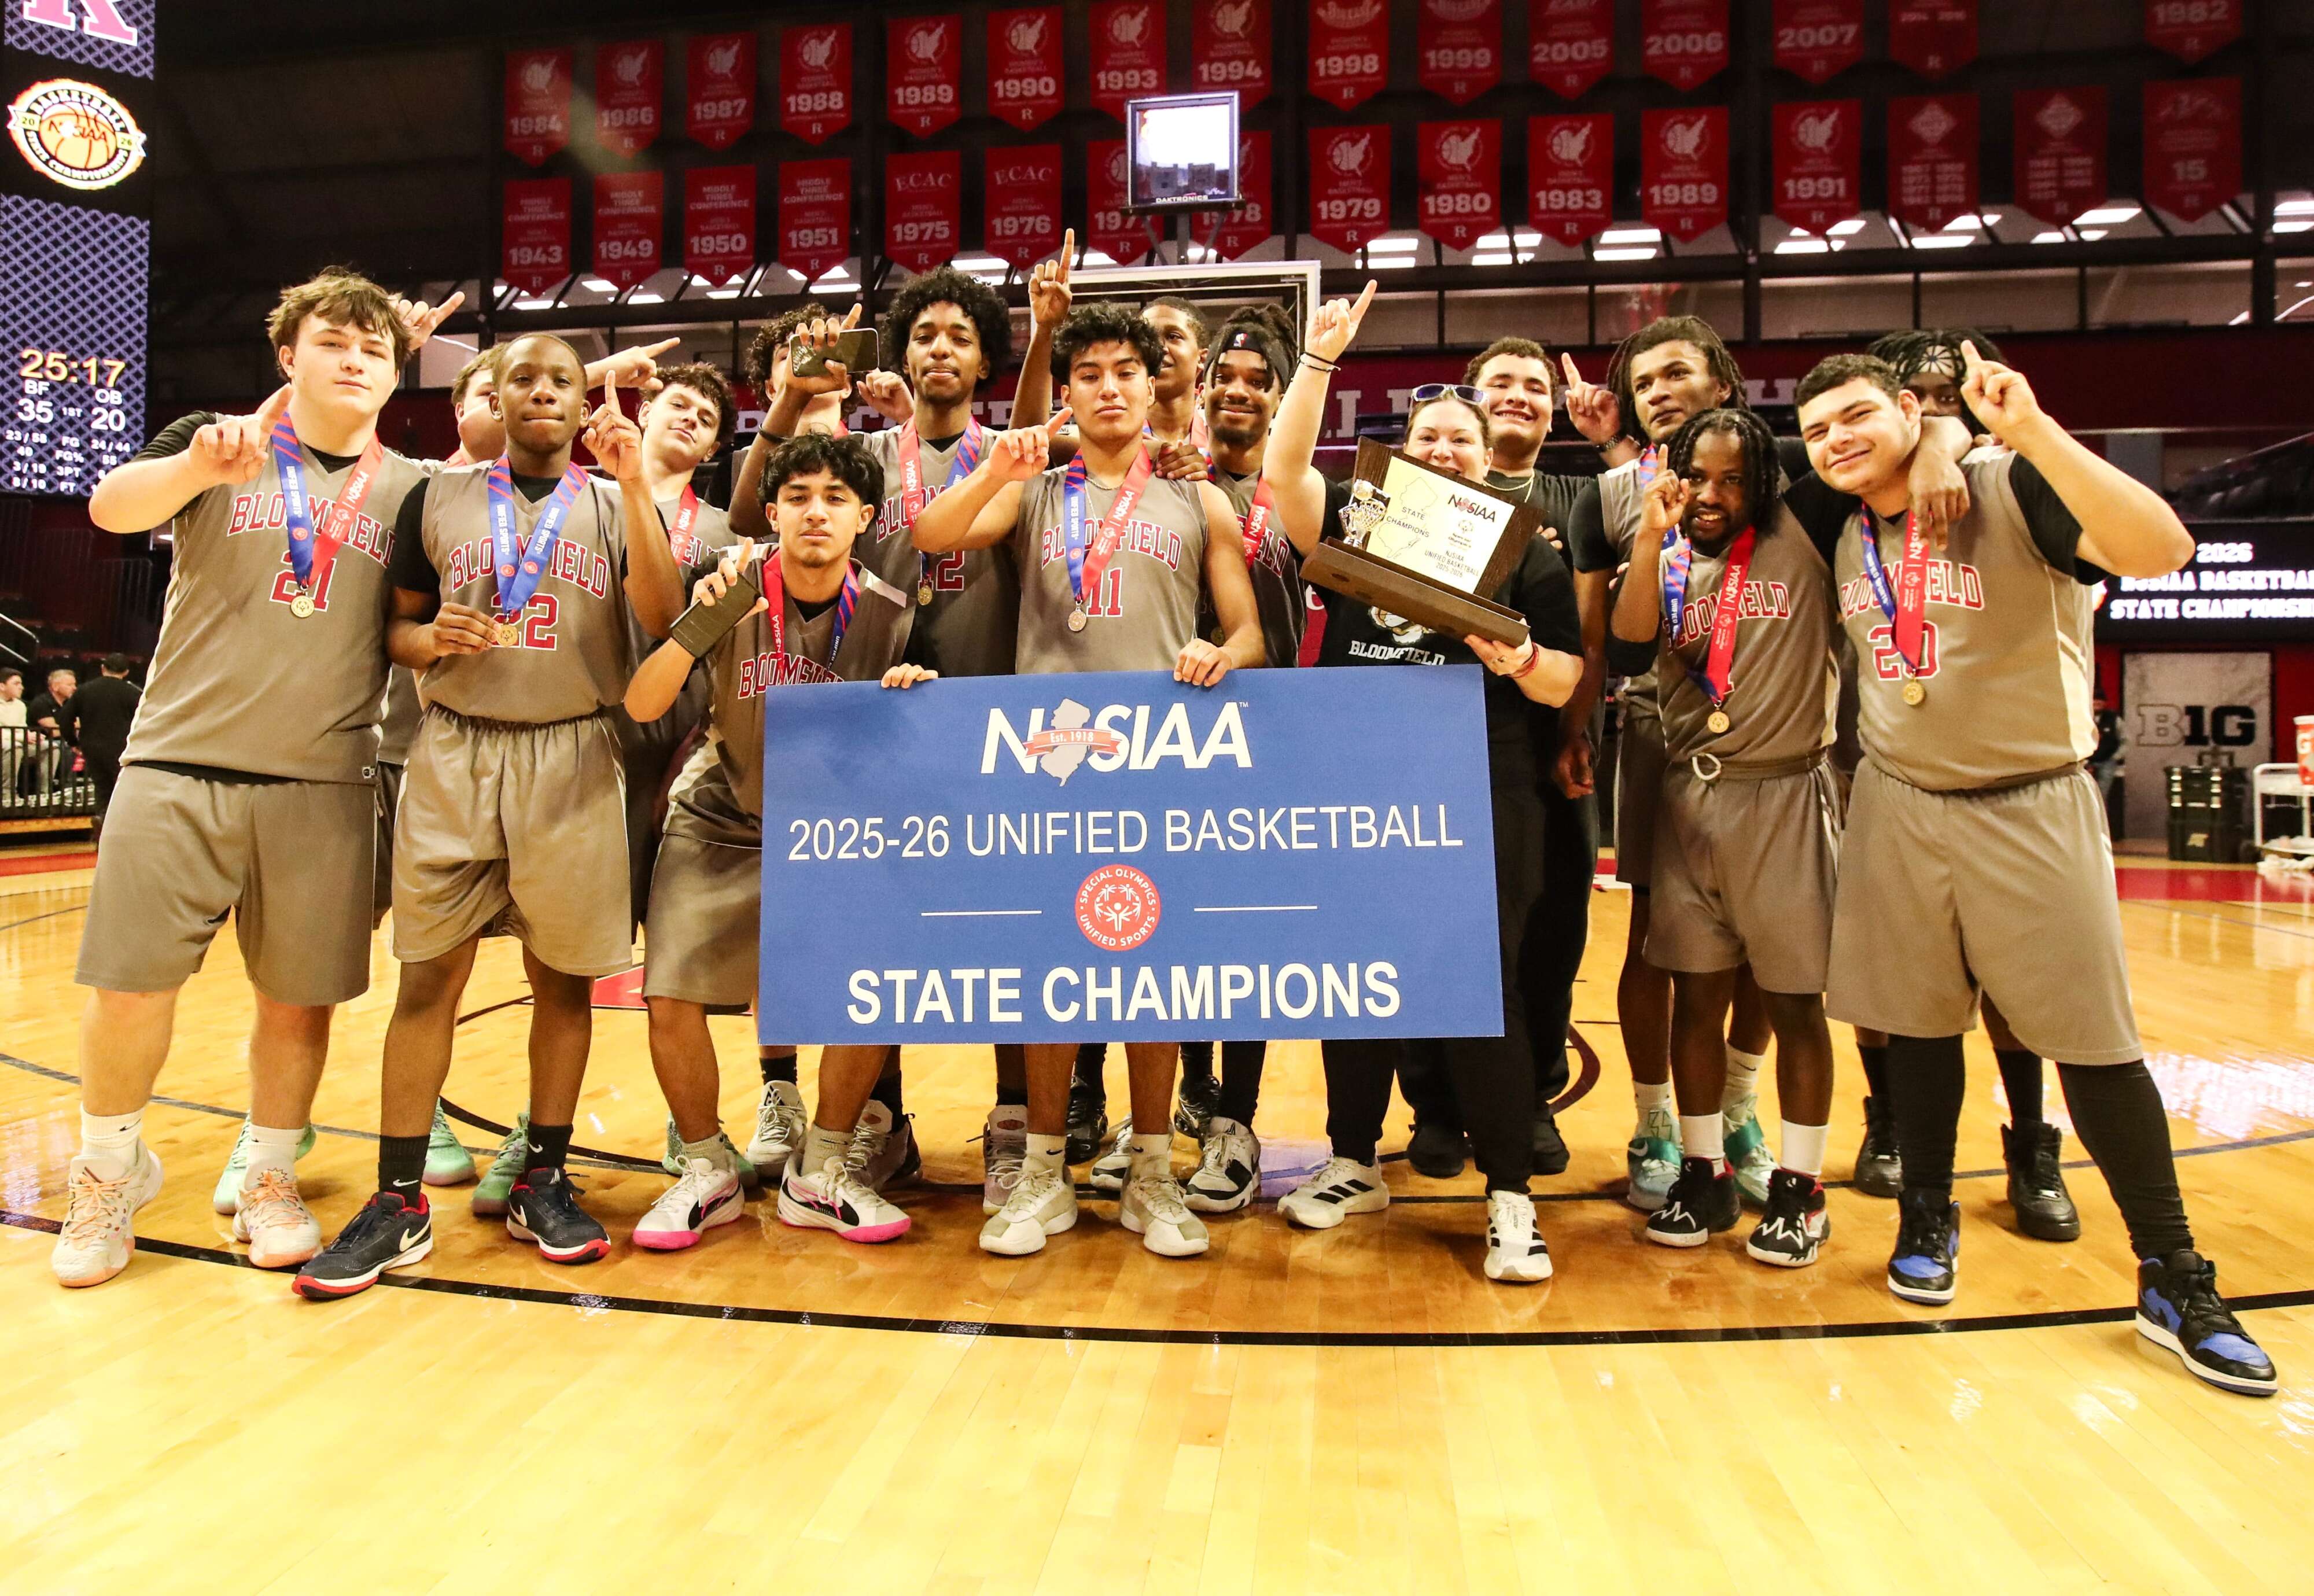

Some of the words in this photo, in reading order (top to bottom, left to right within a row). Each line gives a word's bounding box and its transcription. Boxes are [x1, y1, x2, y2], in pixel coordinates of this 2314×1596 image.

[1646, 32, 1723, 56] 2006
[1777, 24, 1858, 49] 2007
[1424, 48, 1492, 70] 1999
[1533, 39, 1608, 63] 2005
[1198, 59, 1262, 82] 1994
[1316, 54, 1379, 77] 1998
[994, 76, 1056, 98] 1990
[1096, 69, 1158, 90] 1993
[786, 91, 844, 112] 1988
[894, 84, 953, 105] 1989
[601, 106, 654, 127] 1986
[691, 97, 746, 120] 1987
[1022, 109, 1033, 120] R
[21, 117, 35, 126] 20
[48, 119, 107, 142] NSIAA
[510, 115, 562, 135] 1984
[120, 137, 132, 146] 26
[896, 172, 952, 192] ECAC
[994, 165, 1052, 185] ECAC
[2172, 160, 2207, 182] 15
[703, 185, 736, 194] MIDDLE
[797, 178, 831, 187] MIDDLE
[1782, 178, 1845, 200] 1991
[690, 200, 750, 210] CONFERENCE
[783, 193, 844, 204] CONFERENCE
[1156, 195, 1208, 204] DAKTRONICS
[1424, 193, 1492, 215] 1980
[1536, 189, 1603, 210] 1983
[1649, 183, 1718, 205] 1989
[1203, 203, 1262, 225] 178
[1317, 198, 1381, 220] 1979
[893, 220, 950, 242] 1975
[992, 215, 1051, 236] 1976
[1346, 231, 1358, 242] R
[1455, 226, 1466, 238] R
[691, 233, 747, 254] 1950
[788, 227, 839, 248] 1951
[1119, 241, 1130, 253] R
[1227, 236, 1239, 247] R
[509, 245, 563, 266] 1943
[599, 239, 653, 260] 1949
[918, 253, 928, 264] R
[1017, 246, 1029, 258] R
[621, 270, 632, 281] R
[714, 264, 725, 275] R
[810, 259, 820, 270] R
[532, 276, 542, 287] R
[19, 349, 126, 388] 25:17
[24, 379, 50, 395] BF
[94, 388, 123, 405] OB
[17, 398, 54, 423] 35
[62, 407, 83, 417] 1ST
[90, 407, 126, 432] 20
[62, 436, 80, 447] FG
[17, 446, 33, 456] 40
[56, 450, 84, 463] FG%
[57, 466, 82, 477] 3PT
[907, 459, 918, 492] NSIAA
[60, 482, 76, 492] FT
[347, 471, 370, 504] NSIAA
[1113, 490, 1135, 521] NSIAA
[1401, 506, 1425, 521] STATE
[1447, 493, 1496, 523] NSIAA
[227, 492, 396, 569] BLOMEL
[1248, 505, 1266, 537] NSIAA
[1386, 515, 1430, 537] CHAMPIONS
[1042, 519, 1182, 572] BLOFIELD
[1445, 550, 1464, 562] NJSIAA
[449, 533, 609, 599] BLOIELD
[1424, 550, 1446, 563] UNIFIED
[1446, 558, 1479, 577] BASKETBALL
[269, 550, 337, 613] 21
[1085, 567, 1123, 617] 11
[1724, 565, 1742, 603] NSIAA
[1841, 559, 1985, 620] LOMELD
[1662, 581, 1790, 657] LOOELD
[2109, 599, 2180, 620] STATE
[491, 592, 559, 651] 22
[772, 614, 782, 653] NSIAA
[1348, 640, 1446, 666] BLOOMFIELD
[1867, 620, 1941, 681] 20
[738, 651, 845, 699] BOOMFI
[981, 698, 1253, 787] NSIAA
[1050, 731, 1067, 743] Est.
[1070, 730, 1094, 743] 1918
[788, 815, 949, 861] 2025-26
[967, 810, 1148, 857] UNIFIED
[1165, 804, 1464, 853] BASKETBALL
[1079, 869, 1113, 904] SPECIAL
[1115, 868, 1156, 906] OLYMPICS
[1079, 913, 1117, 946] UNIFIED
[1119, 915, 1156, 946] SPORTS
[847, 968, 1023, 1025] STATE
[1042, 961, 1401, 1023] CHAMPIONS
